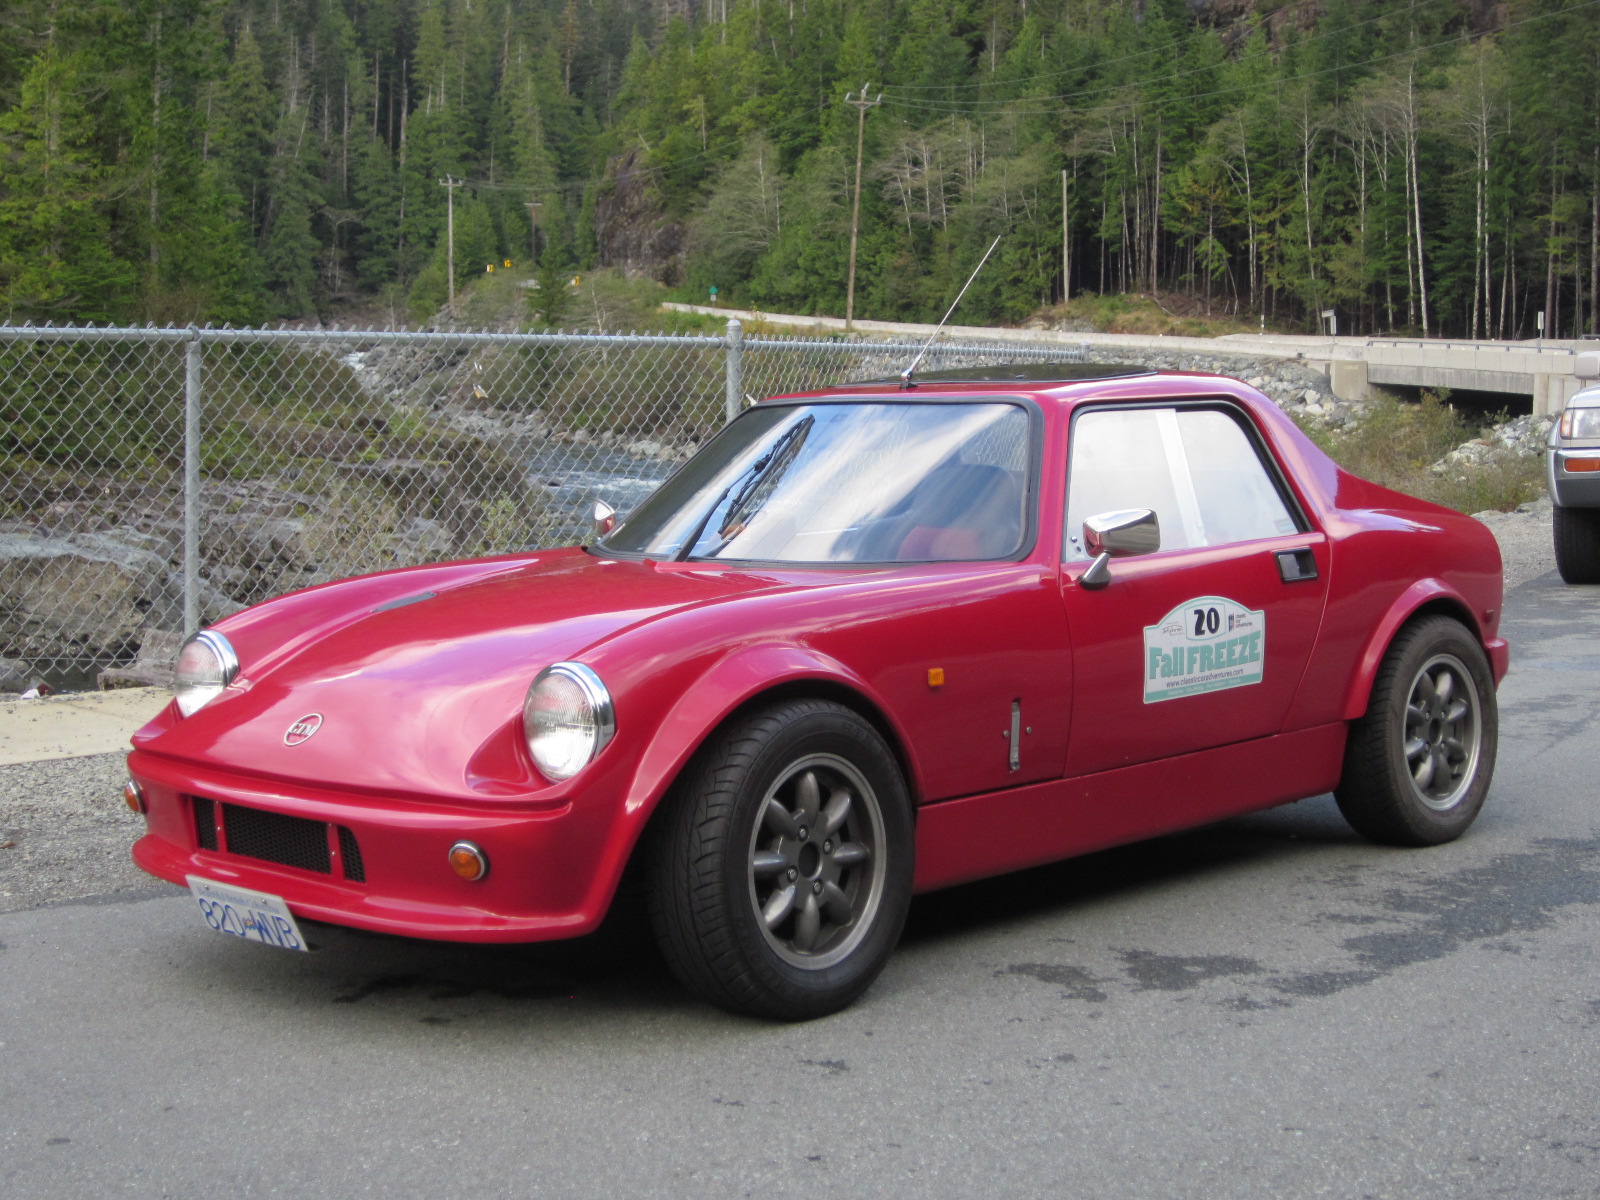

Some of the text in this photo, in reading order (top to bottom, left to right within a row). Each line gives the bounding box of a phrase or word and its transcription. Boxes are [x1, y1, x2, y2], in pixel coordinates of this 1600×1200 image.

[1193, 607, 1220, 636] 20
[1149, 630, 1261, 680] Fall FREEZE
[1166, 668, 1244, 688] www.classiccaradventures.com
[199, 897, 300, 949] 820 WVB
